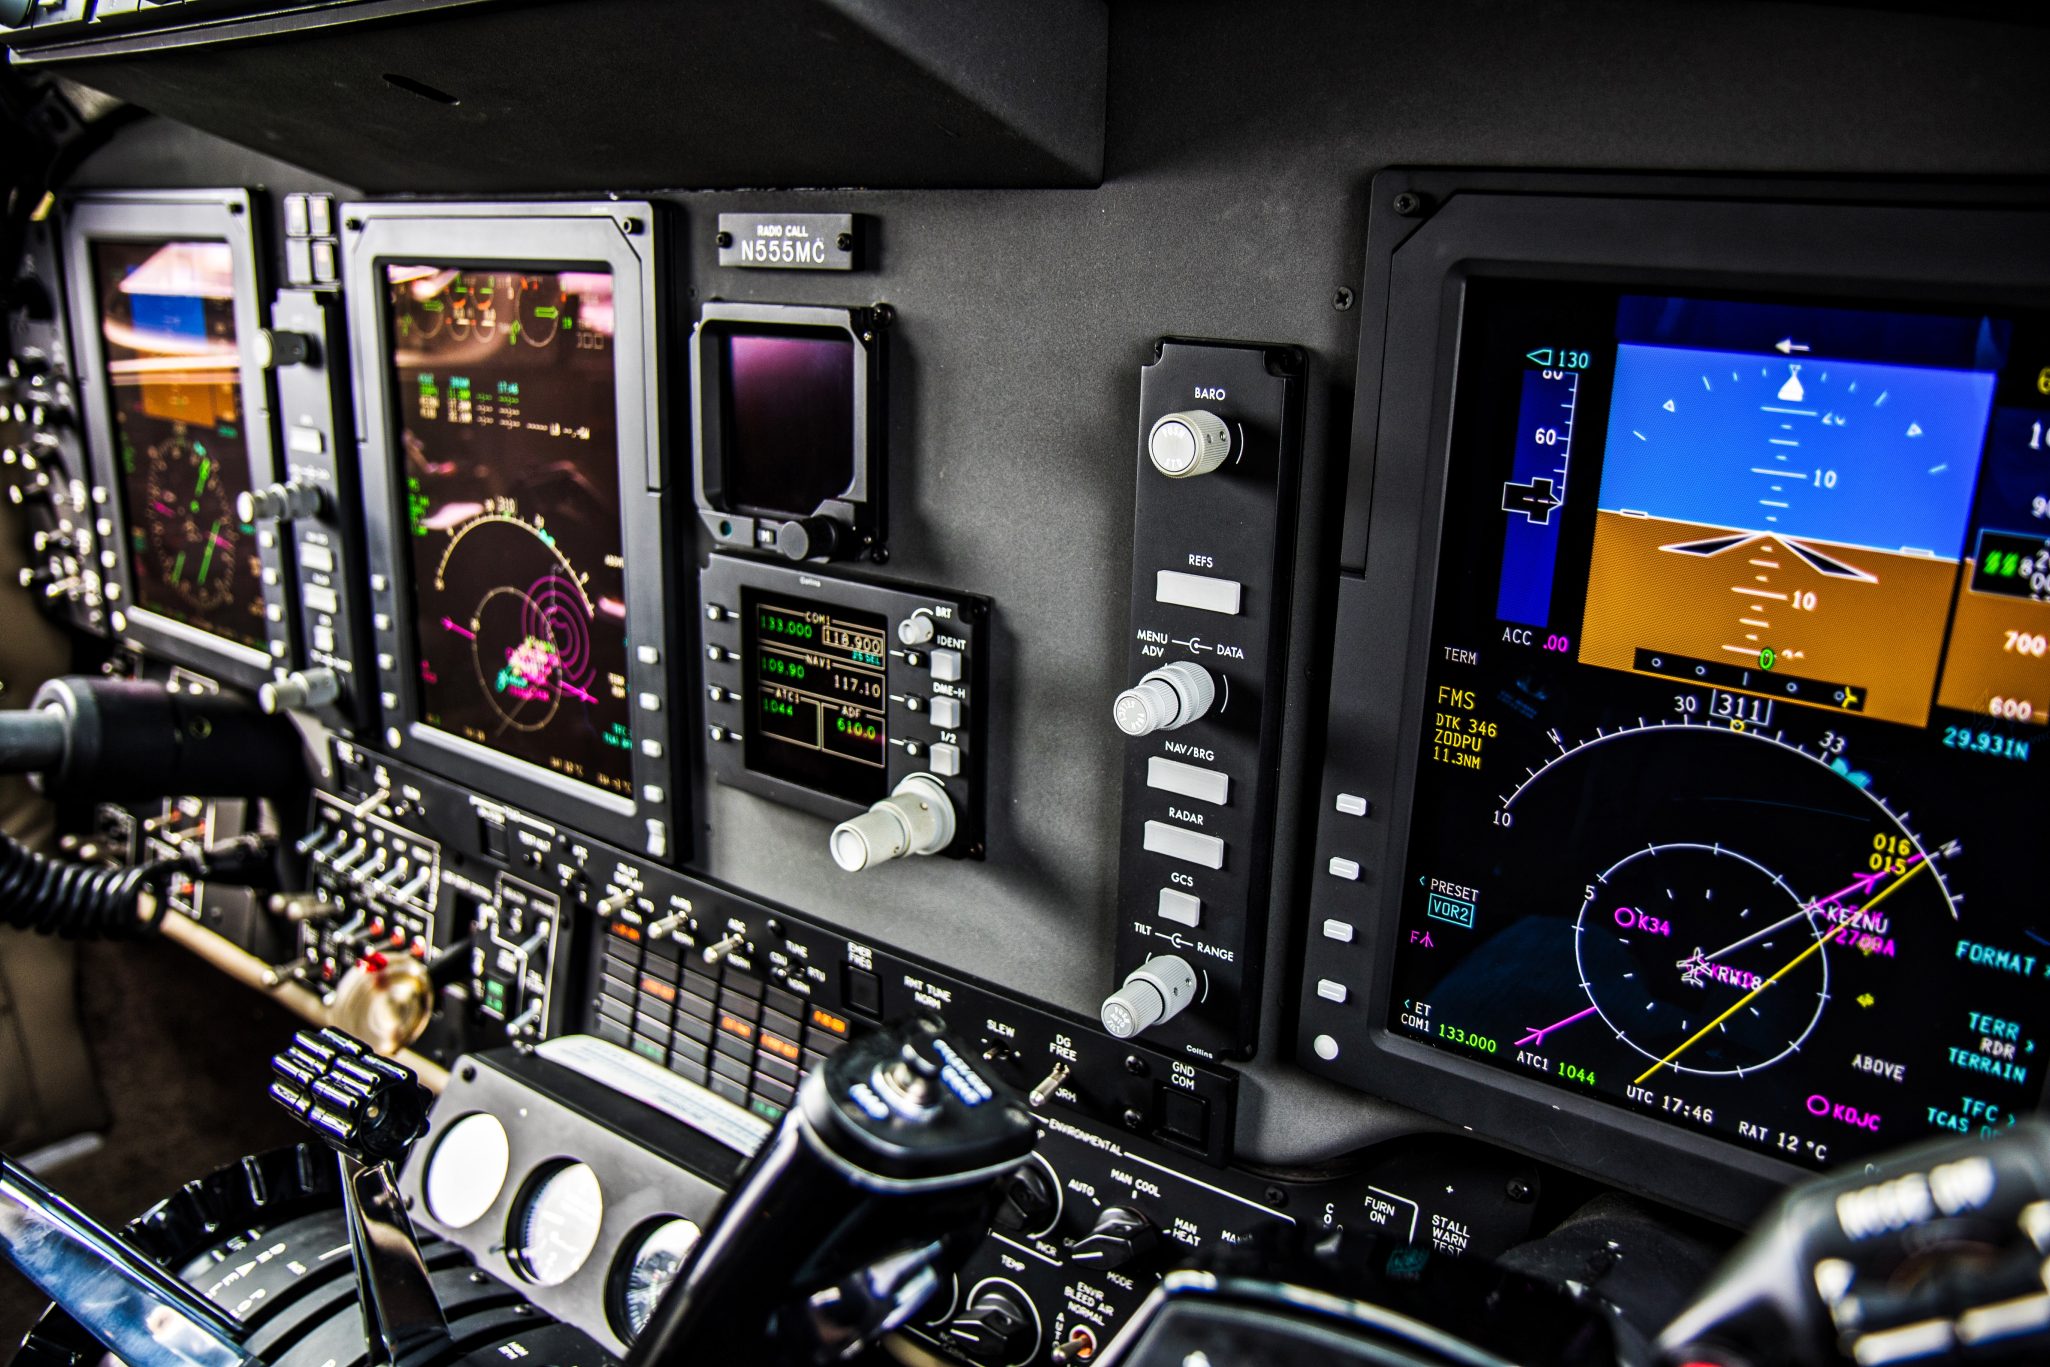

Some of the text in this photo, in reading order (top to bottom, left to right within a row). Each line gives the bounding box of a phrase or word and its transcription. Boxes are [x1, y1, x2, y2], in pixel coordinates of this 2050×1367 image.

[757, 224, 808, 238] RADIO CALL
[741, 239, 825, 263] N555MC
[1558, 350, 1588, 368] 130
[1194, 387, 1226, 401] BARO
[1535, 429, 1556, 445] 60
[1813, 470, 1838, 489] 10
[1188, 554, 1214, 568] REFS
[1792, 590, 1818, 612] 10
[805, 611, 830, 626] COM1
[936, 606, 952, 618] BRT
[761, 615, 812, 638] 133.000
[1137, 628, 1169, 645] MENU
[1502, 627, 1532, 646] ACC
[826, 629, 881, 654] 118.900
[936, 634, 966, 650] IDENT
[1142, 644, 1164, 658] ADV
[1542, 634, 1568, 652] .00
[2003, 630, 2048, 658] 700
[805, 654, 831, 670] NAV1
[1217, 644, 1244, 660] DATA
[1444, 646, 1478, 666] TERM
[761, 656, 805, 680] 109.90
[775, 687, 800, 704] ATC1
[834, 674, 881, 698] 117.10
[932, 682, 966, 699] DME-H
[763, 698, 794, 716] 1044
[1438, 686, 1476, 710] FMS
[1674, 696, 1696, 712] 30
[1718, 694, 1760, 721] 311
[841, 705, 862, 718] ADF
[1988, 696, 2032, 722] 600
[836, 718, 876, 740] 610.0
[1436, 712, 1498, 738] DTK 346
[940, 730, 957, 744] 1/2
[1434, 728, 1482, 752] ZODPU
[1547, 728, 1562, 744] W
[1818, 731, 1845, 754] 33
[1942, 725, 2030, 762] 29.93IN
[1165, 740, 1215, 762] NAV/BRG
[1434, 746, 1481, 770] 11.3NM
[1168, 807, 1204, 826] RADAR
[1493, 810, 1512, 828] 10
[1873, 833, 1910, 857] 016
[1940, 838, 1962, 858] N
[1869, 853, 1907, 876] 015
[1171, 872, 1194, 888] GCS
[1430, 878, 1480, 902] PRESET
[1584, 885, 1595, 900] 5
[1434, 900, 1468, 922] VOR2
[1134, 922, 1152, 938] TILT
[1638, 913, 1670, 937] K34
[1197, 942, 1234, 962] RANGE
[1954, 940, 2037, 978] FORMAT
[926, 984, 952, 1003] TUNE
[1415, 1001, 1432, 1017] ET
[986, 1018, 1016, 1038] SLEW
[1401, 1013, 1430, 1033] COM1
[1968, 1011, 2020, 1041] TERR
[1056, 1034, 1072, 1048] DG
[1438, 1023, 1497, 1053] 133.000
[1980, 1036, 2016, 1060] RDR
[1050, 1043, 1078, 1062] FREE
[1186, 1044, 1213, 1060] Collins
[1172, 1061, 1195, 1077] GND
[1516, 1050, 1597, 1086] ATC1 1044
[1852, 1054, 1906, 1082] ABOVE
[1948, 1047, 2028, 1084] TERRAIN
[1172, 1074, 1195, 1090] COM
[1626, 1084, 1714, 1124] UTC 17:46
[1962, 1096, 2000, 1122] TFC
[1832, 1103, 1882, 1132] KDJC
[1927, 1106, 1970, 1134] TCAS
[1738, 1120, 1768, 1142] RAT
[1777, 1132, 1799, 1152] 12
[1068, 1178, 1095, 1198] AUTO
[1110, 1168, 1162, 1198] MAN COOL
[1364, 1196, 1396, 1217] FURN
[1174, 1217, 1198, 1235] MAN
[1369, 1210, 1386, 1225] ON
[1432, 1214, 1470, 1238] STALL
[1172, 1228, 1200, 1248] HEAT
[1432, 1226, 1468, 1249] WARN
[1001, 1254, 1026, 1272] TEMP
[1106, 1271, 1134, 1290] MODE
[1064, 1285, 1096, 1308] BLEED
[1068, 1301, 1106, 1326] NORMAL
